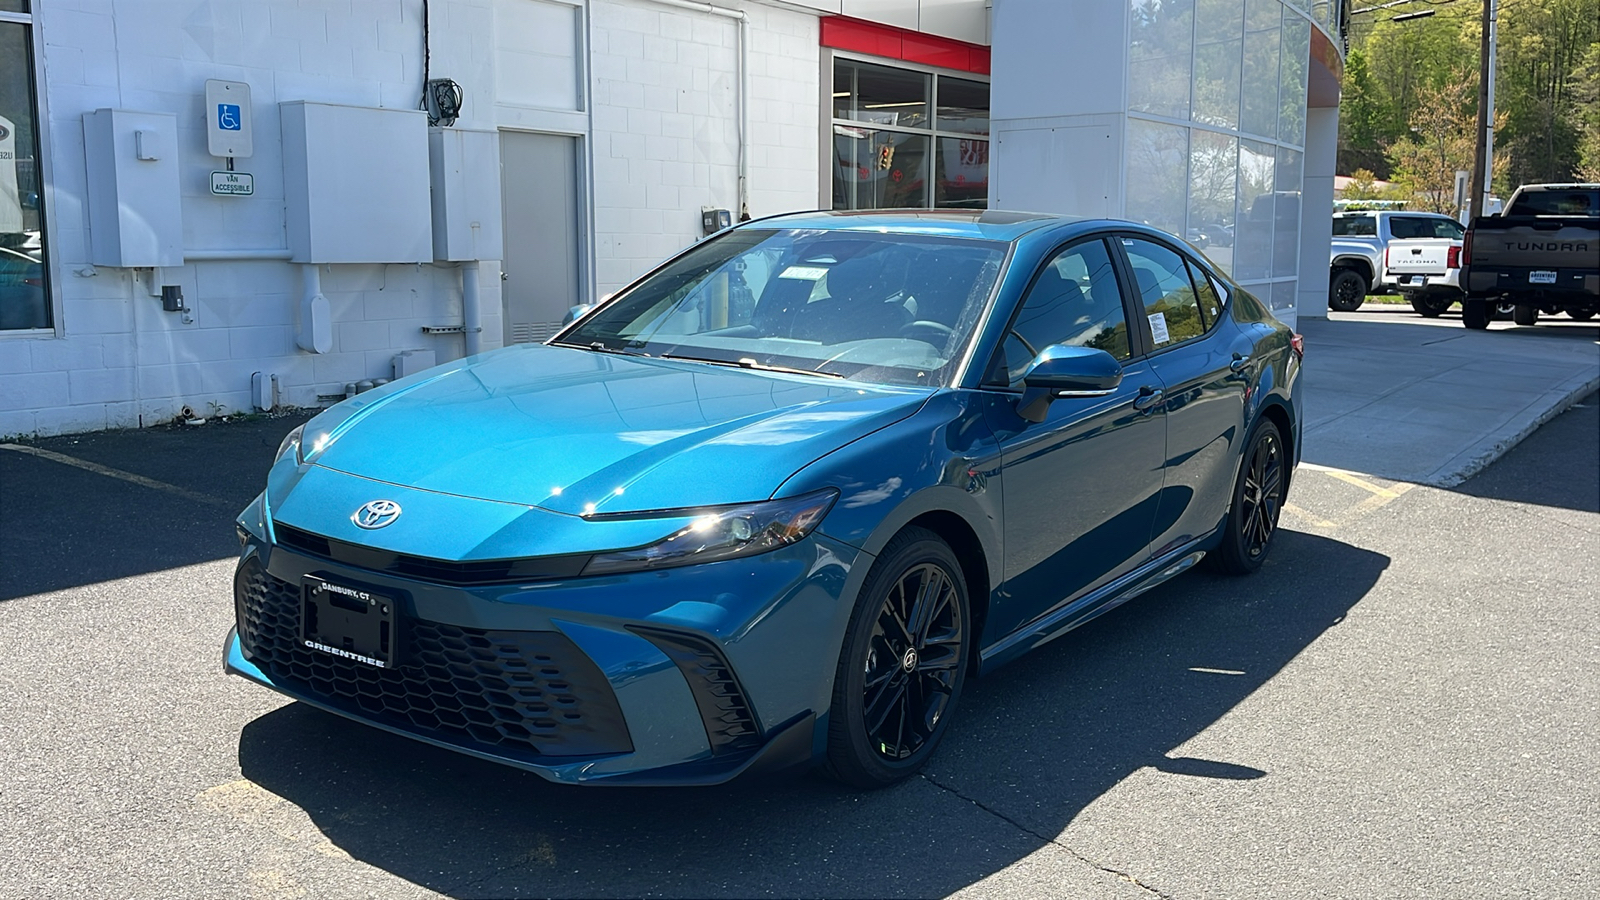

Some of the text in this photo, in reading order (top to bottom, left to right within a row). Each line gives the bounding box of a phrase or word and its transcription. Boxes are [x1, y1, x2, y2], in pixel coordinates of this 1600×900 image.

[226, 175, 239, 183] VAN
[215, 183, 251, 192] ACCESSIBLE
[1504, 242, 1589, 252] TUNDRA
[321, 582, 370, 600] DANBURY, CT
[304, 640, 385, 668] GREENTREE
